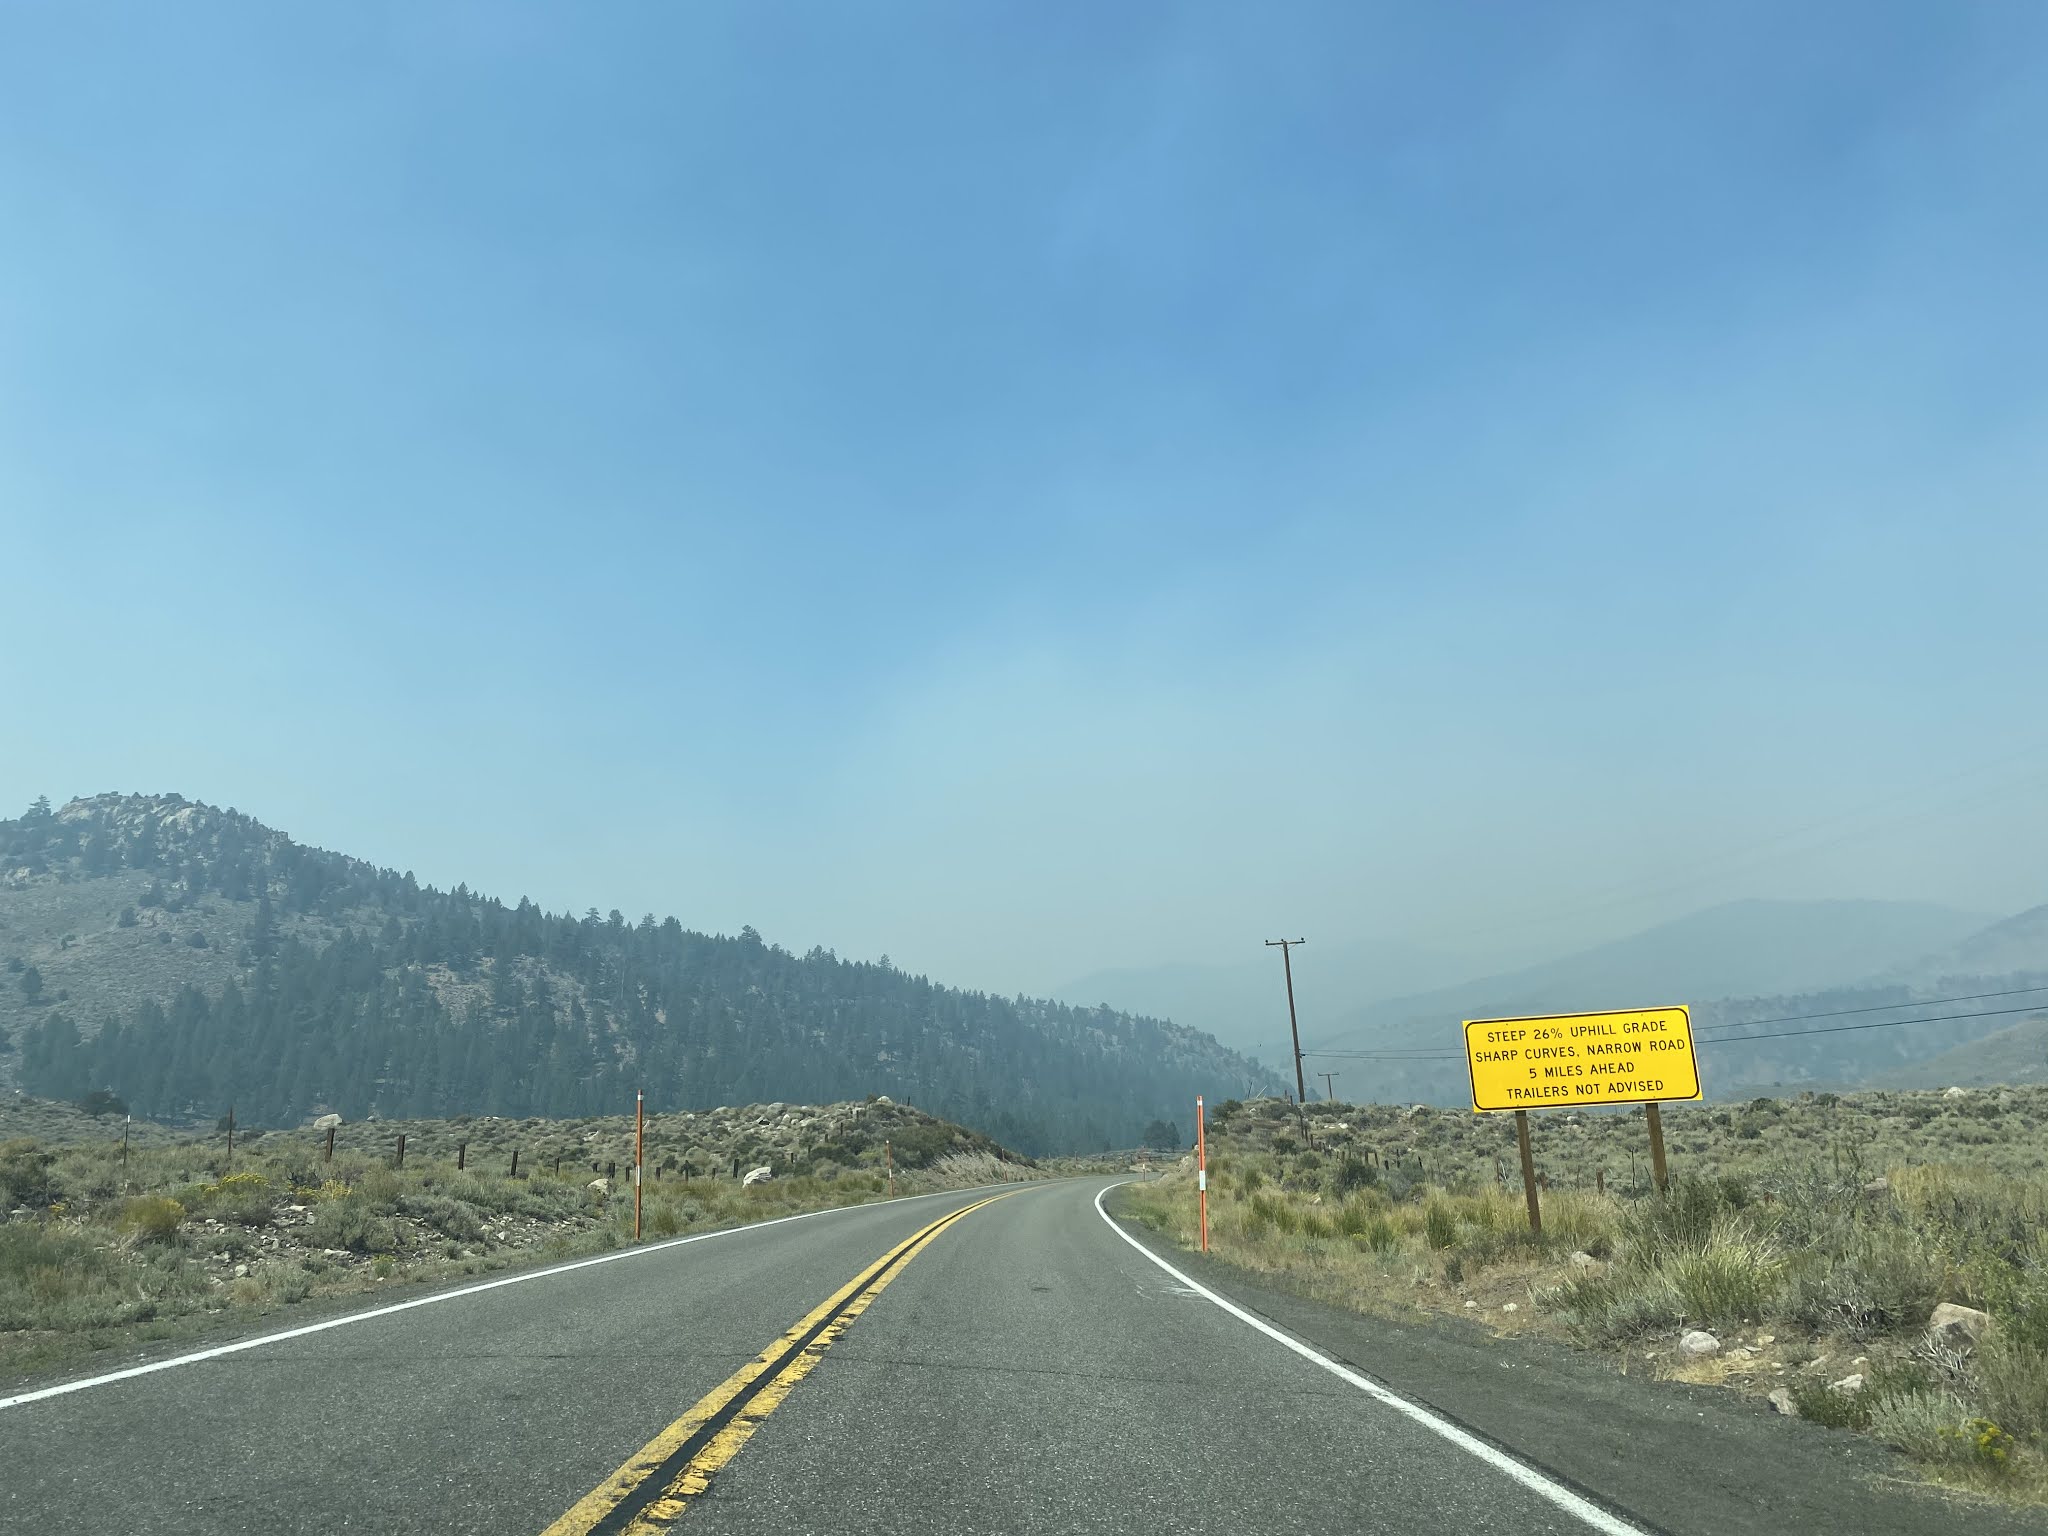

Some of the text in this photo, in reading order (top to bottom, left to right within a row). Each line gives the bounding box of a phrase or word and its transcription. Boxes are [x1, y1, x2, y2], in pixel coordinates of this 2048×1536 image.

[1487, 1020, 1668, 1043] STEEP 26% UPHILL GRADE
[1475, 1038, 1686, 1063] SHARP CURVES, NARROW ROAD
[1529, 1061, 1635, 1079] 5 MILES AHEAD
[1506, 1079, 1664, 1100] TRAILERS NOT ADVISED
